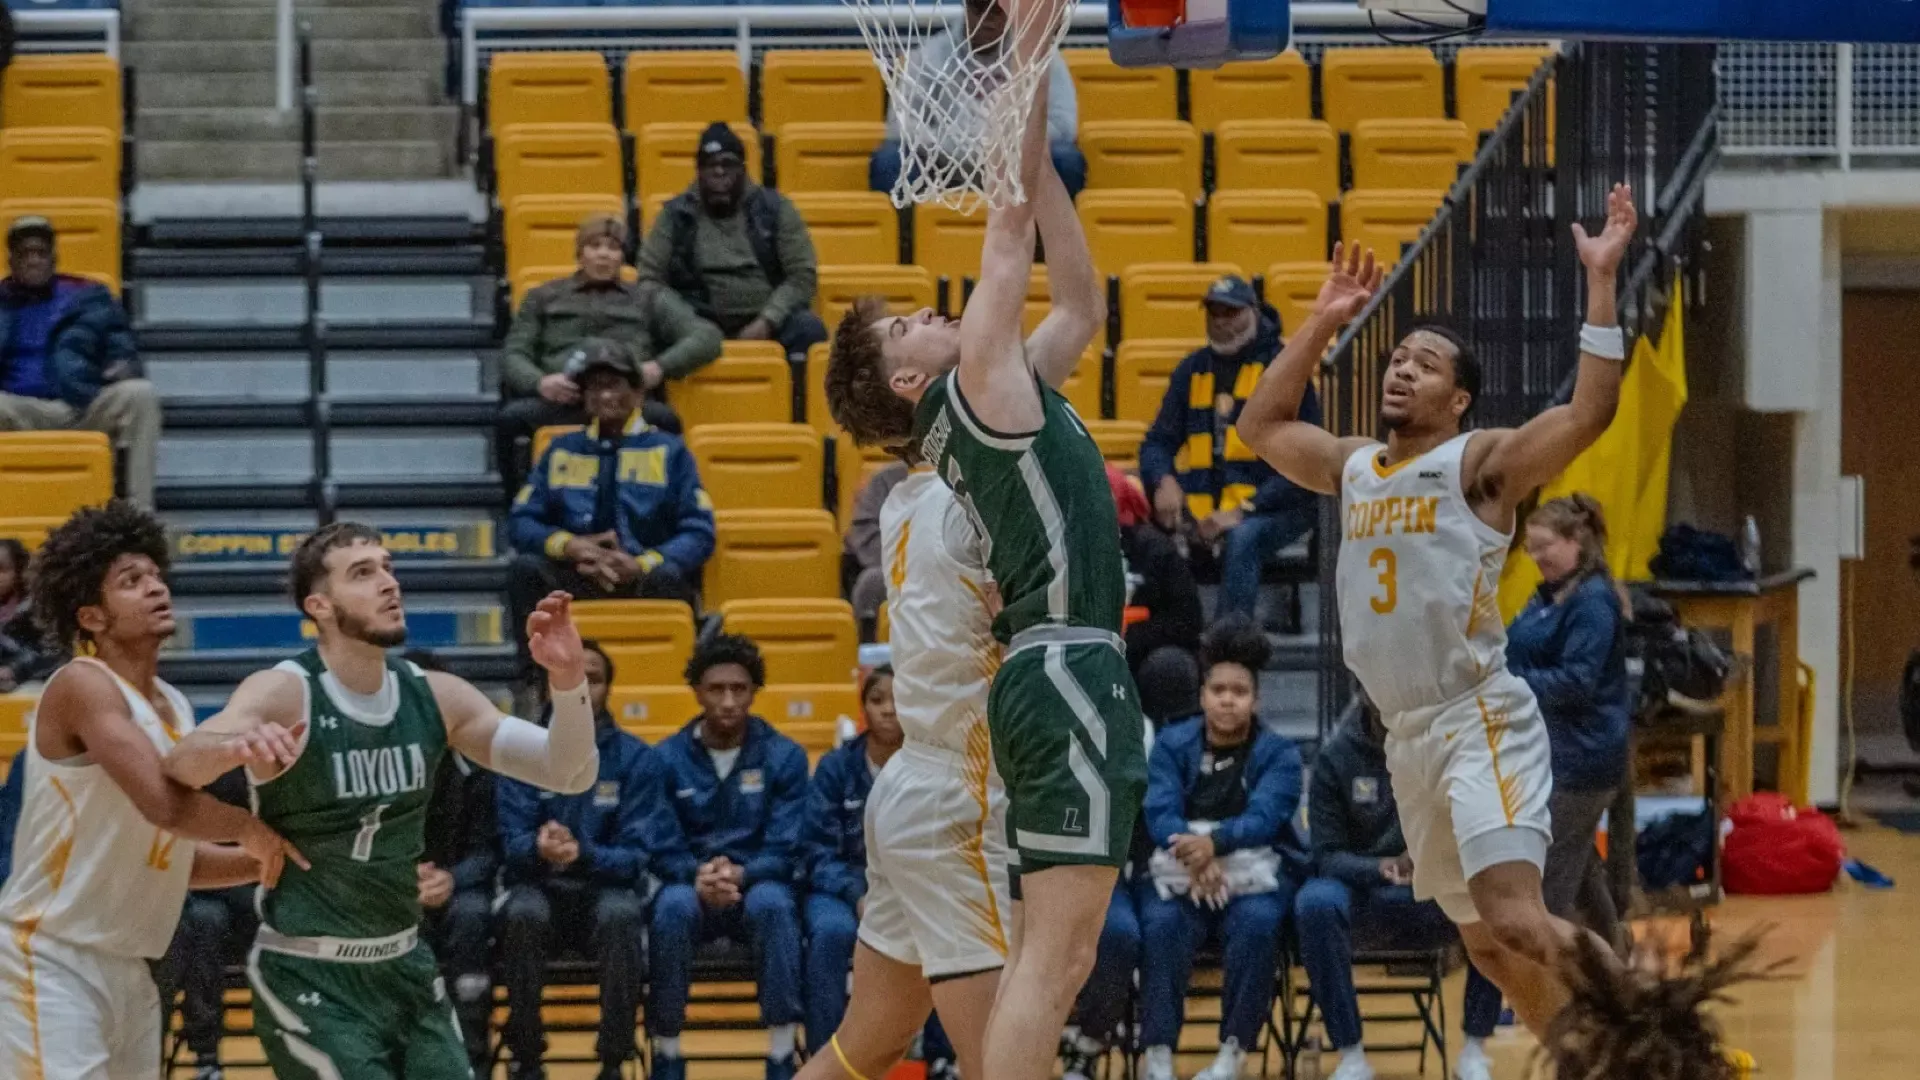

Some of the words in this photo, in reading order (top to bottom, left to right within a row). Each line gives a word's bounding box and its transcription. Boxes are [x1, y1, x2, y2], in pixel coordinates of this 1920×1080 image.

[381, 532, 459, 552] AGLES
[1348, 496, 1440, 541] COPPIN
[1368, 547, 1397, 615] 3
[331, 743, 427, 799] LOYOLA
[351, 803, 392, 862] 1
[1062, 807, 1083, 833] L
